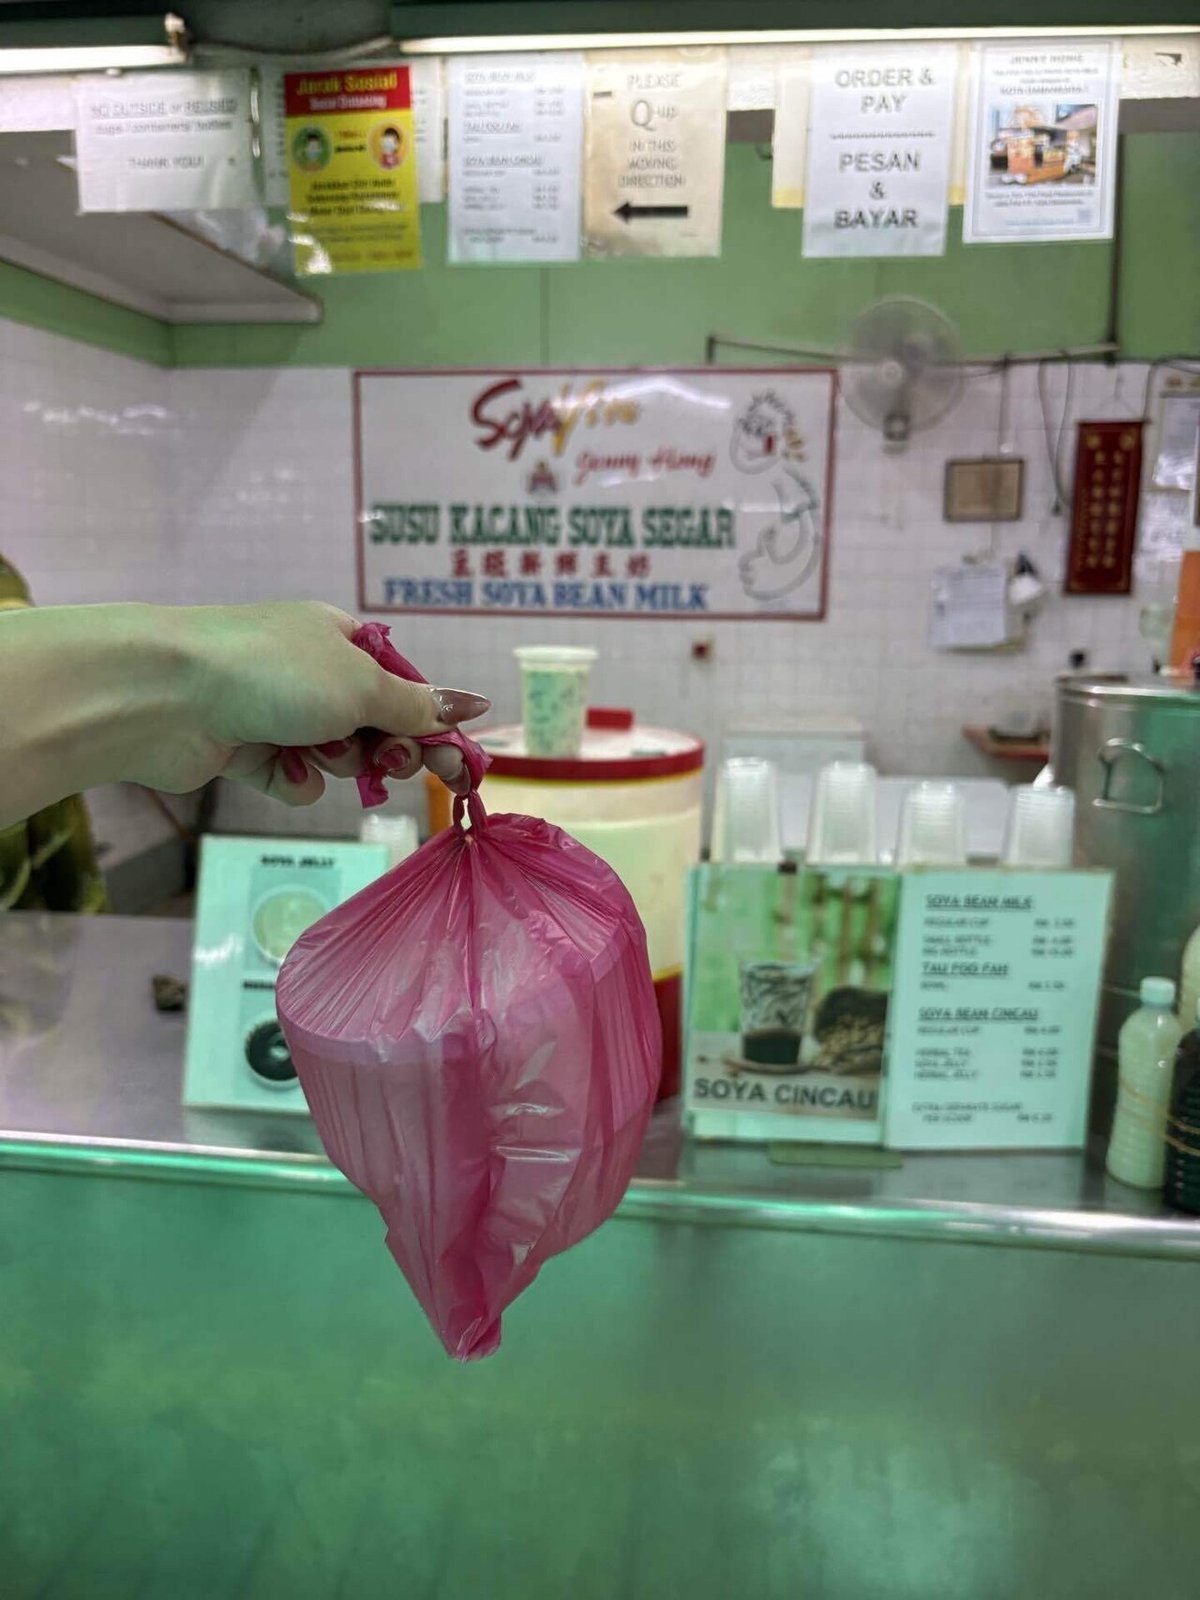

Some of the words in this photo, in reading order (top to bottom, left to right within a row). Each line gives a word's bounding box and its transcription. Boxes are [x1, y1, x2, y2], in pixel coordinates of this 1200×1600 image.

[627, 74, 681, 88] PLEASE
[834, 69, 913, 88] ORDER
[919, 68, 935, 86] &
[860, 95, 907, 113] PAY
[839, 151, 921, 172] PESAN
[617, 173, 687, 188] DIRECTION
[869, 180, 887, 200] &
[833, 209, 919, 229] BAYAR
[371, 503, 440, 545] SUSU
[448, 504, 561, 546] KACANG
[568, 506, 634, 547] SOYA
[643, 507, 736, 548] SEGAR
[383, 576, 473, 605] FRESH
[480, 579, 548, 607] SOYA
[553, 581, 626, 609] BEAN
[633, 583, 708, 611] MILK
[926, 894, 960, 908] SOYA
[963, 894, 998, 909] BEAN
[693, 1077, 767, 1102] SOYA
[774, 1083, 878, 1110] CINCAU
